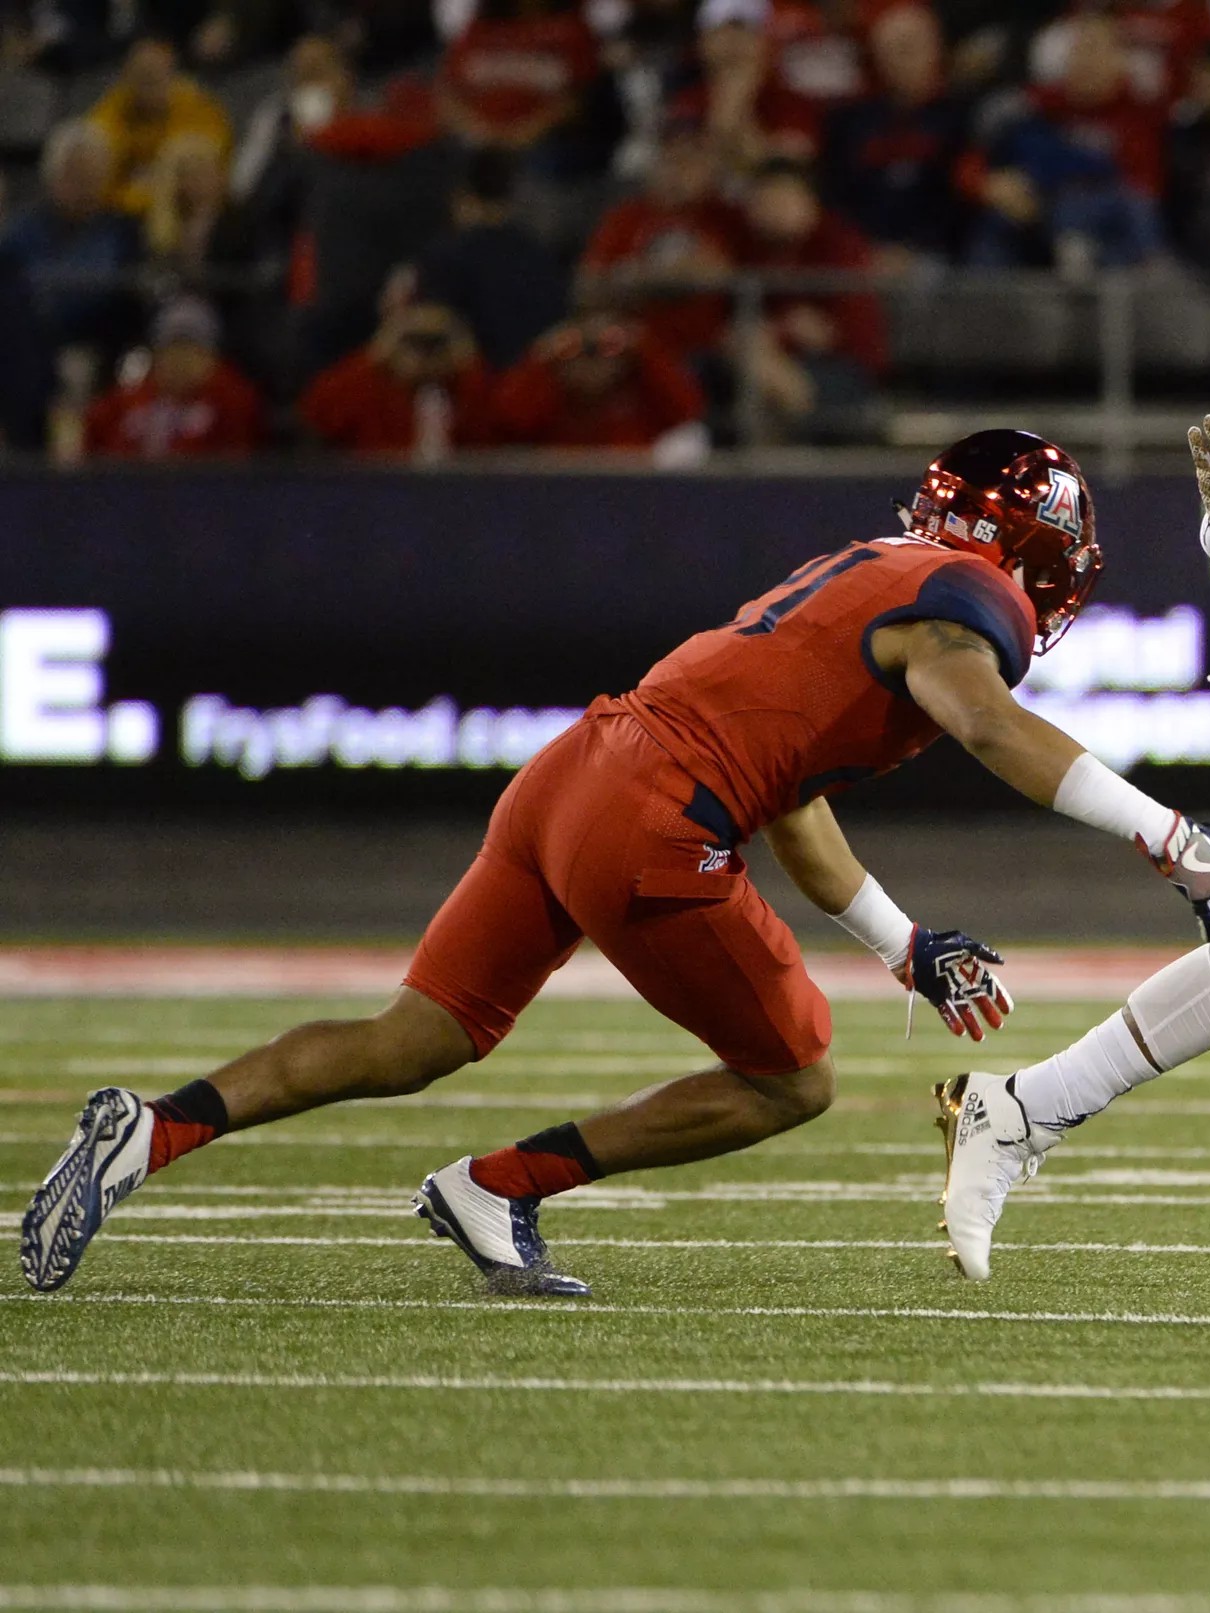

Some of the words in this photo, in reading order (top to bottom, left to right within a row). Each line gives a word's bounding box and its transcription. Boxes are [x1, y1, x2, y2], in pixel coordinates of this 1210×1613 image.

[972, 518, 998, 545] 65
[1036, 467, 1084, 540] A
[0, 606, 157, 766] E.
[958, 1092, 979, 1146] adidas
